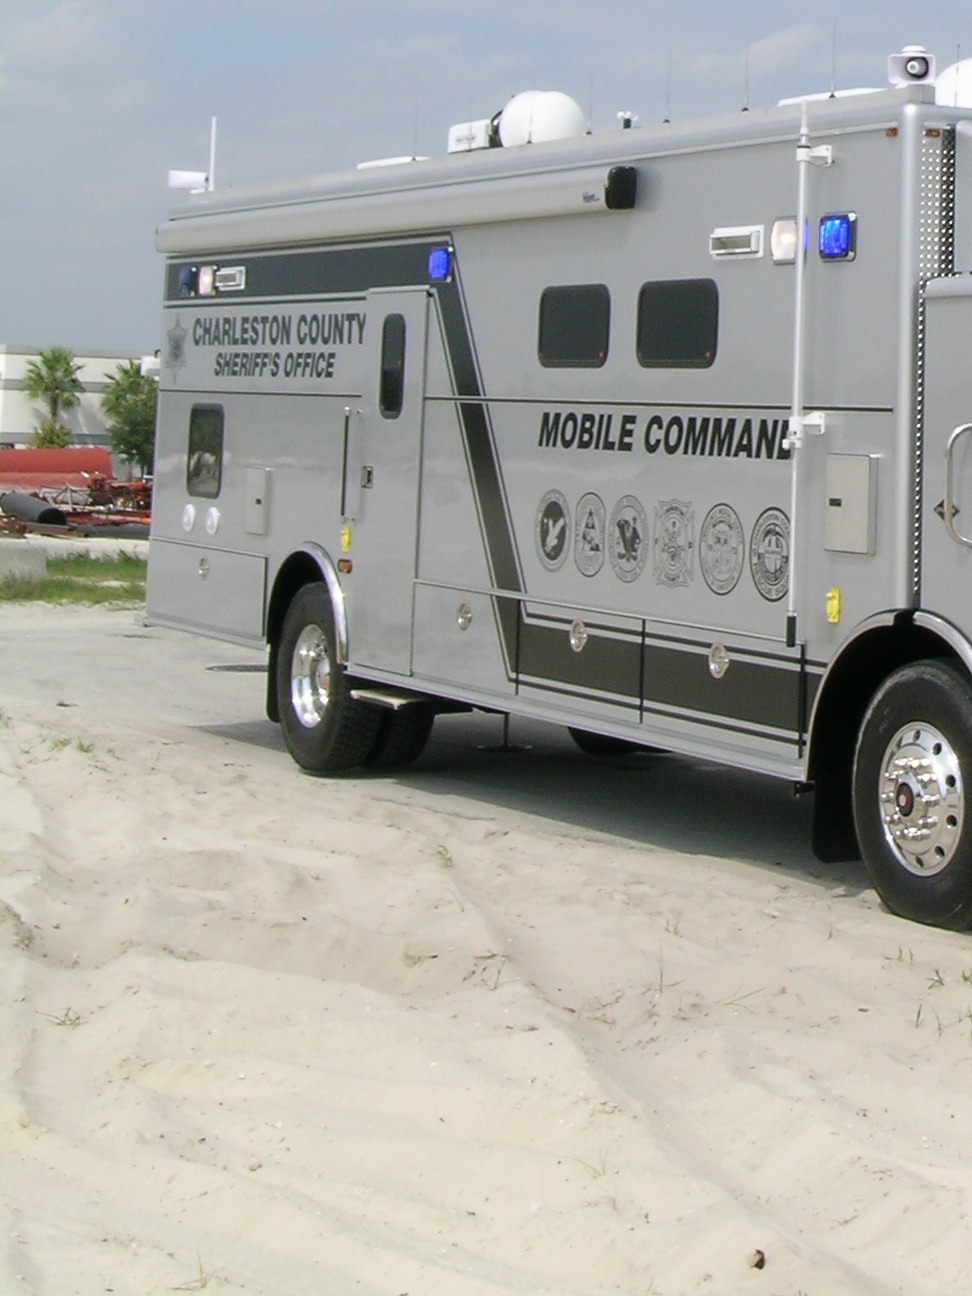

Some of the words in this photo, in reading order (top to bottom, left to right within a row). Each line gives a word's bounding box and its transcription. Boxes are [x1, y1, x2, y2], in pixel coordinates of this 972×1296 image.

[193, 314, 291, 346] CHARLESTON
[297, 313, 366, 345] COUNTY
[214, 352, 279, 376] SHERIFF'S
[284, 352, 336, 378] OFFICE
[538, 411, 637, 452] MOBILE
